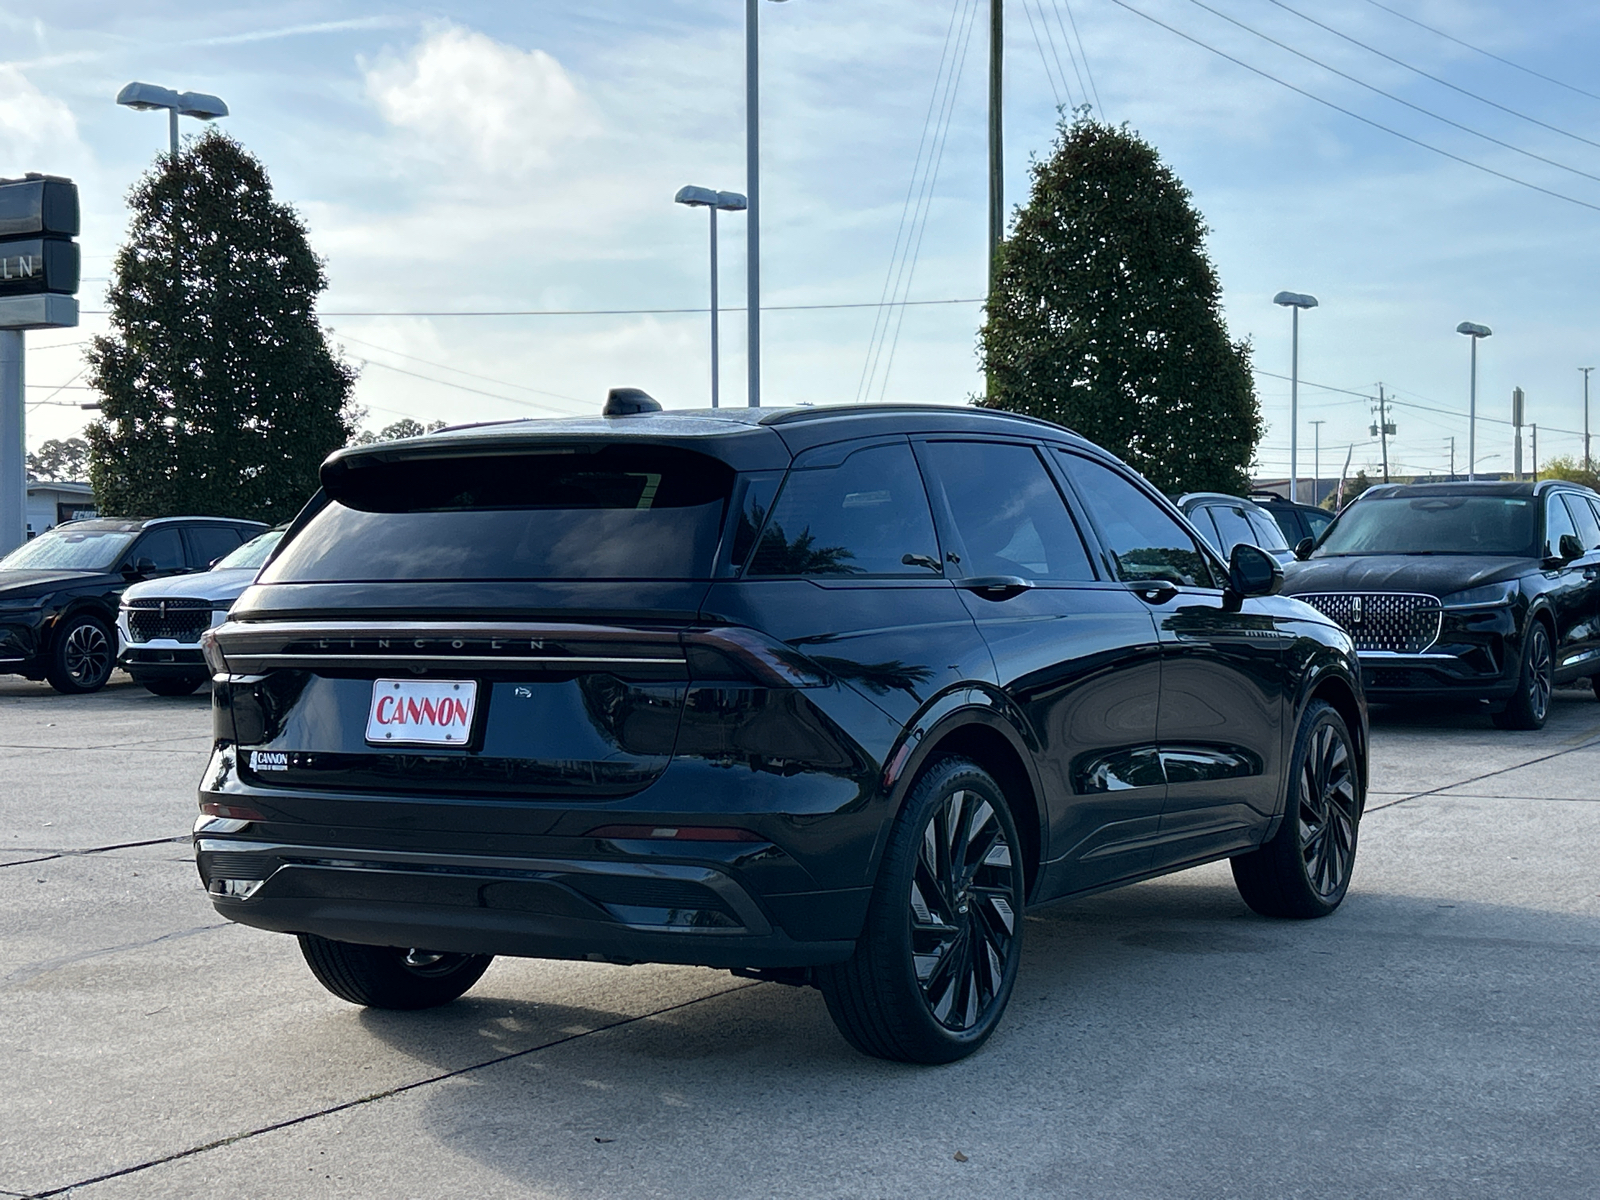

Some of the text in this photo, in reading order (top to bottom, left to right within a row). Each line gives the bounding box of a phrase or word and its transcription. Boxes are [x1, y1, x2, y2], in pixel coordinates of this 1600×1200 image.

[319, 638, 544, 650] LINCOLN
[376, 695, 470, 727] CANNON
[257, 752, 288, 765] CANNON
